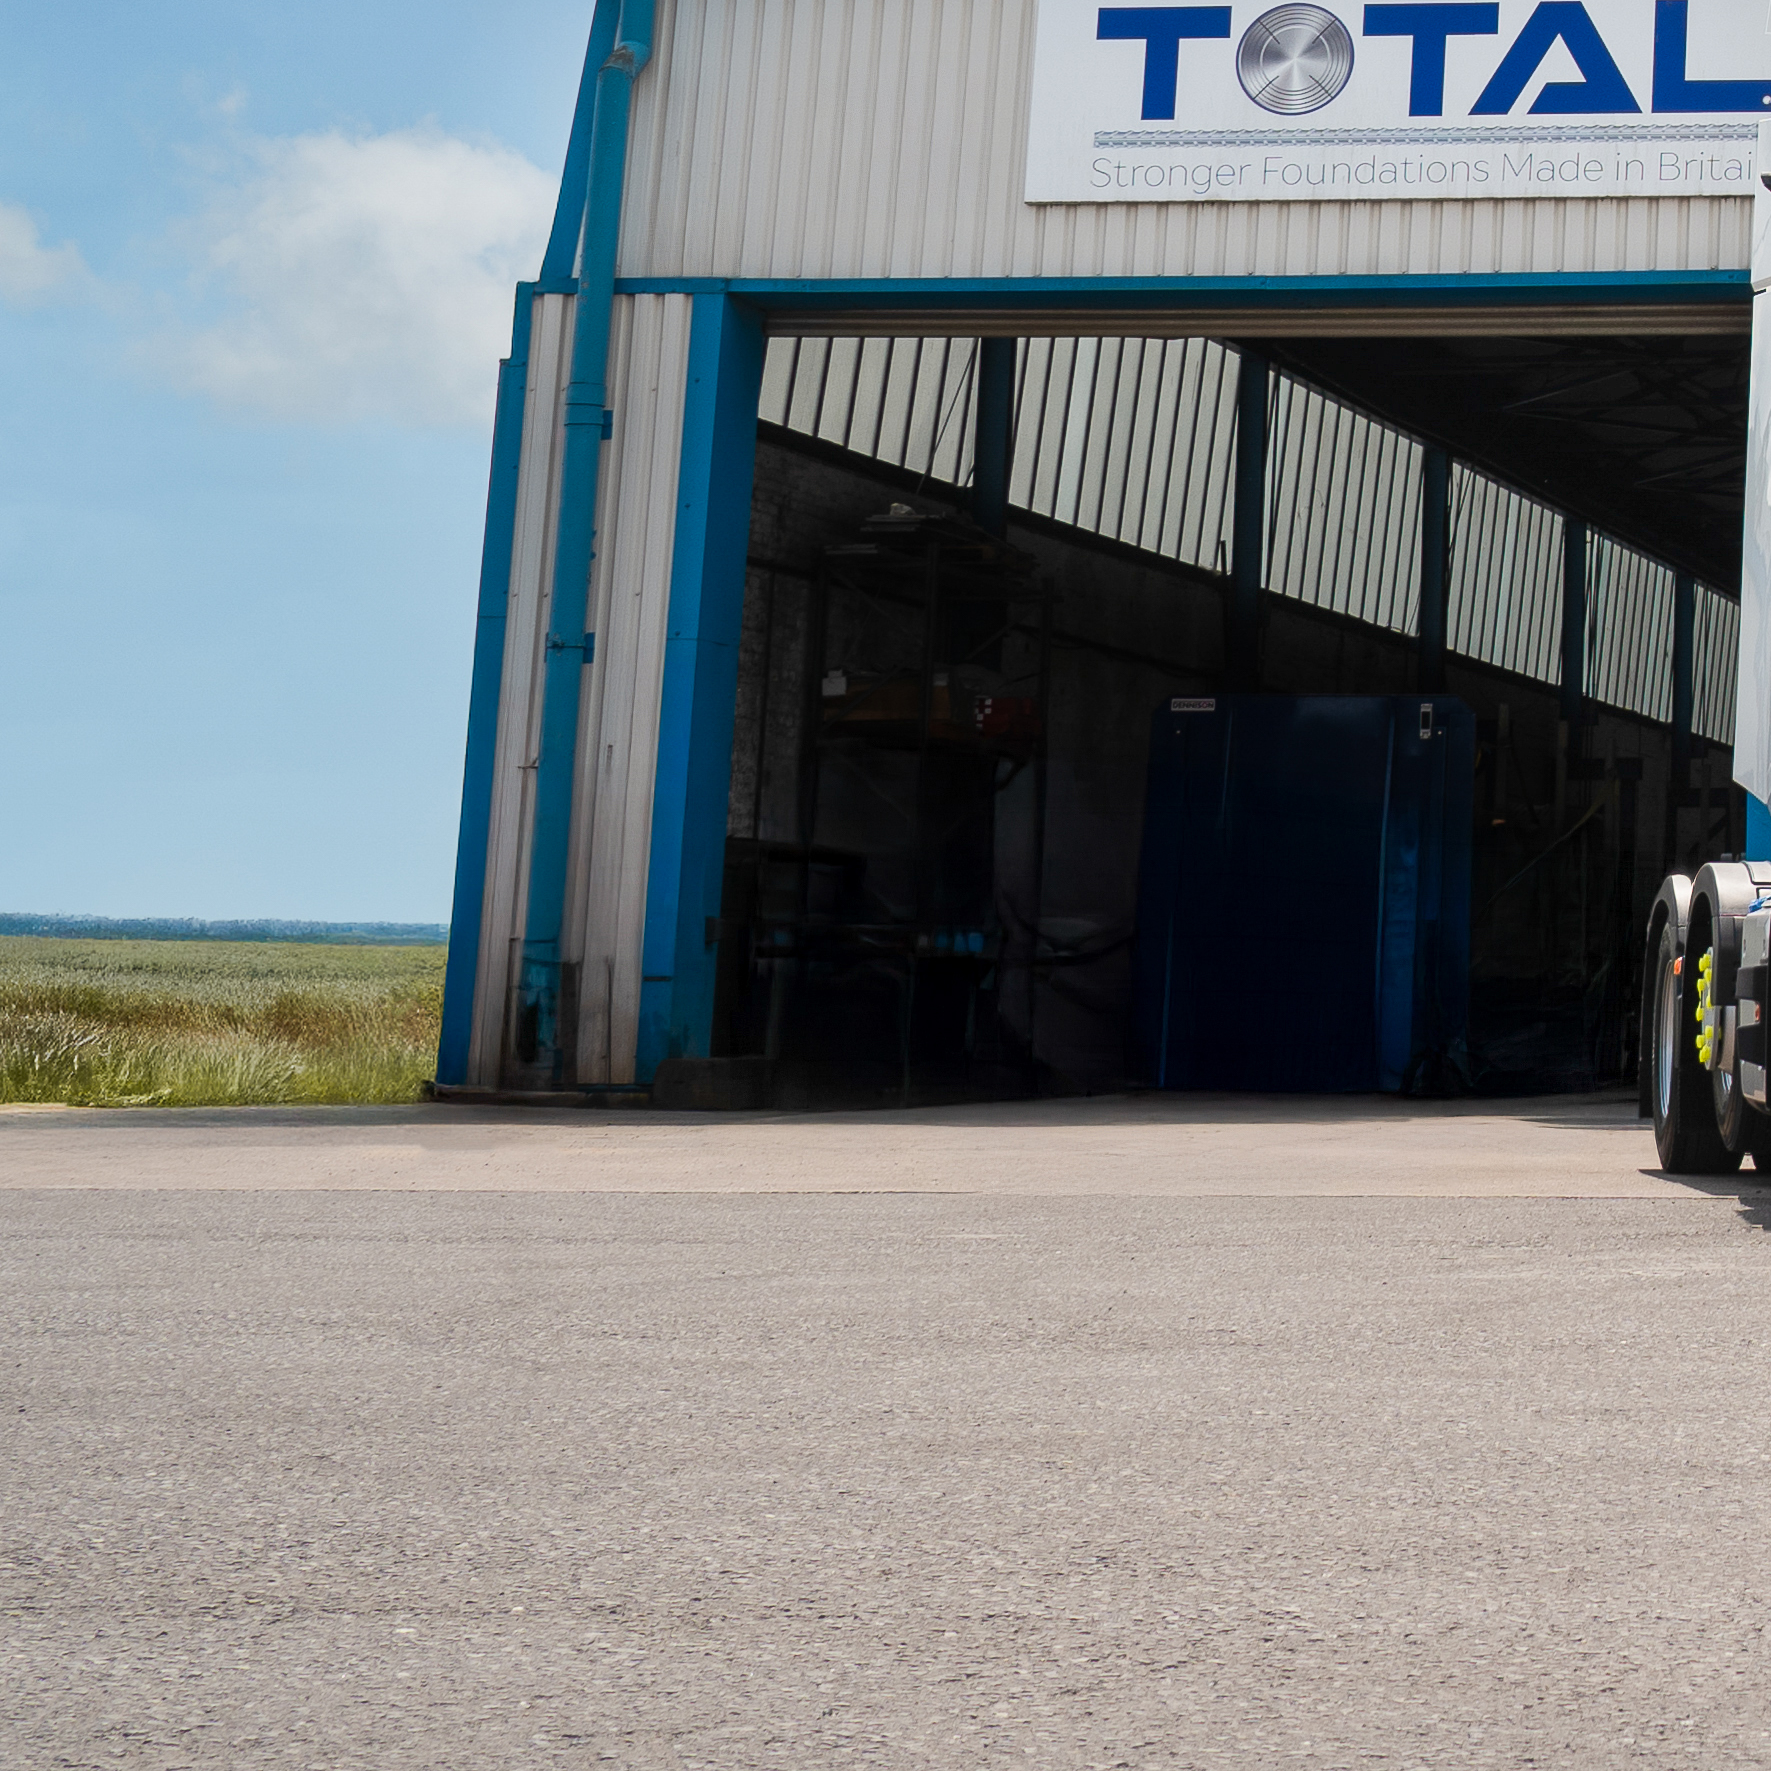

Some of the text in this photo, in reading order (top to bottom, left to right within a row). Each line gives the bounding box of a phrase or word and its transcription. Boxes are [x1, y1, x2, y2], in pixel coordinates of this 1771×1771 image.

[1090, 151, 1752, 195] Stronger Foundations Made in Britai
